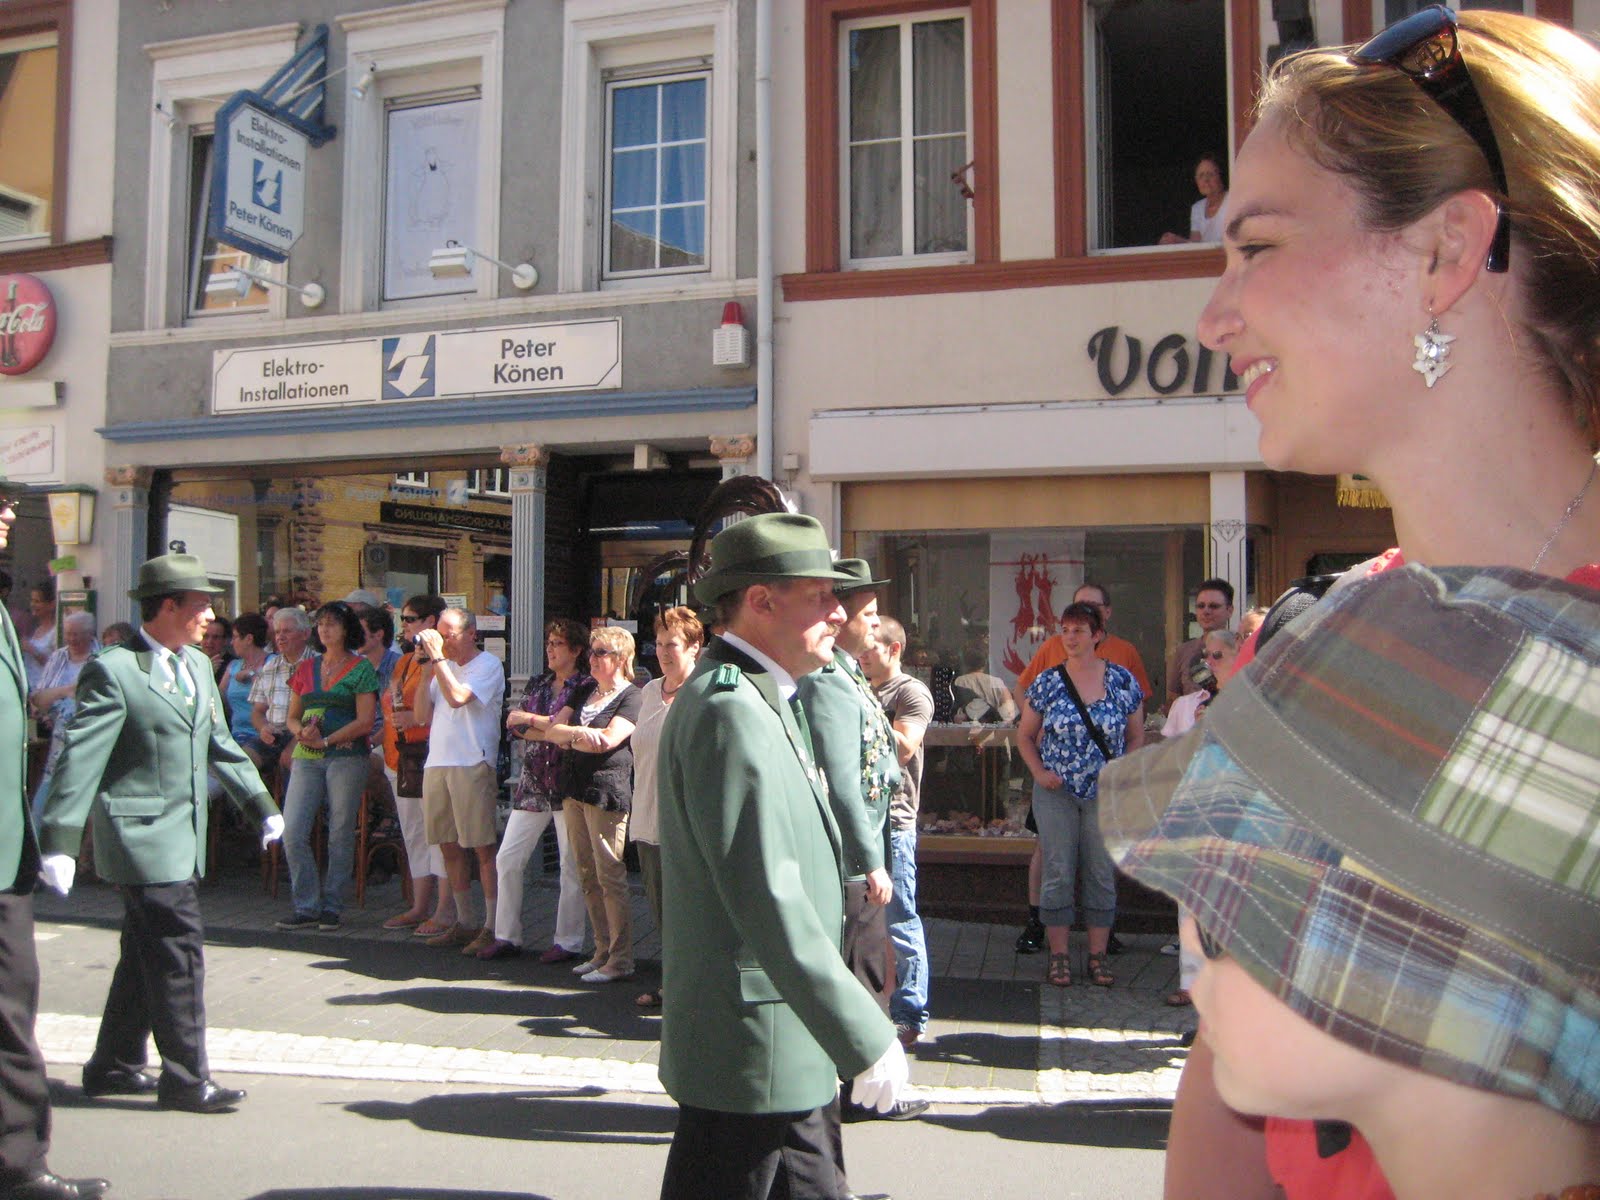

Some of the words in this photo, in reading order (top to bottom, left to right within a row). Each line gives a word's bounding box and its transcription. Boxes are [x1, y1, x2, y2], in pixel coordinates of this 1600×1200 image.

[251, 117, 288, 144] Elektro-
[236, 130, 301, 172] Installationen
[229, 201, 258, 224] Peter
[258, 214, 293, 241] Könen
[501, 338, 556, 360] Peter
[263, 358, 325, 378] Elektro-
[493, 363, 564, 384] Könen
[239, 382, 349, 403] Installationen
